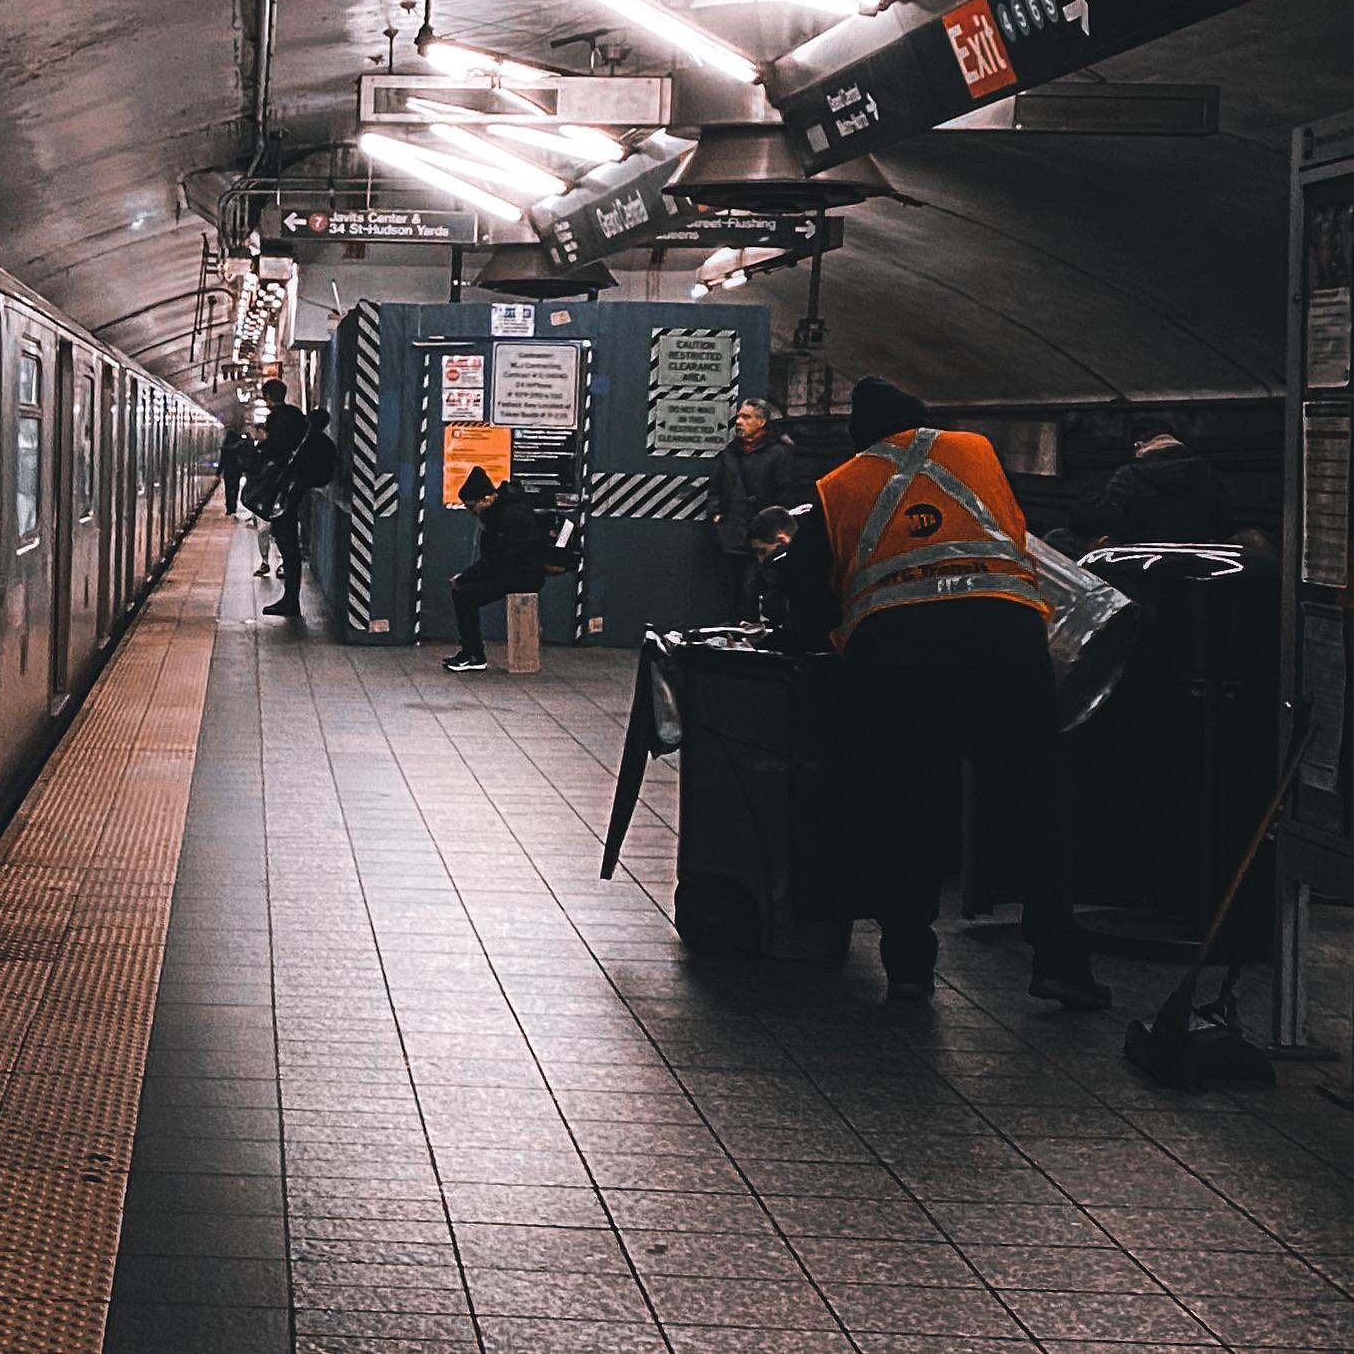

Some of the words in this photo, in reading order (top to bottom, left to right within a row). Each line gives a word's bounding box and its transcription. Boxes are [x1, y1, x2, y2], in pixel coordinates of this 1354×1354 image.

[948, 14, 1007, 85] Exit
[1002, 11, 1013, 33] 4
[1015, 3, 1026, 27] 5
[329, 212, 364, 224] Javits
[368, 213, 408, 224] Center
[328, 224, 346, 234] 34
[417, 225, 449, 237] Yards
[676, 340, 715, 349] CAUTION
[668, 351, 723, 361] RESTRICTED
[668, 362, 721, 372] CLEARANCE
[682, 373, 706, 382] AREA
[657, 434, 702, 443] CLEARANCE
